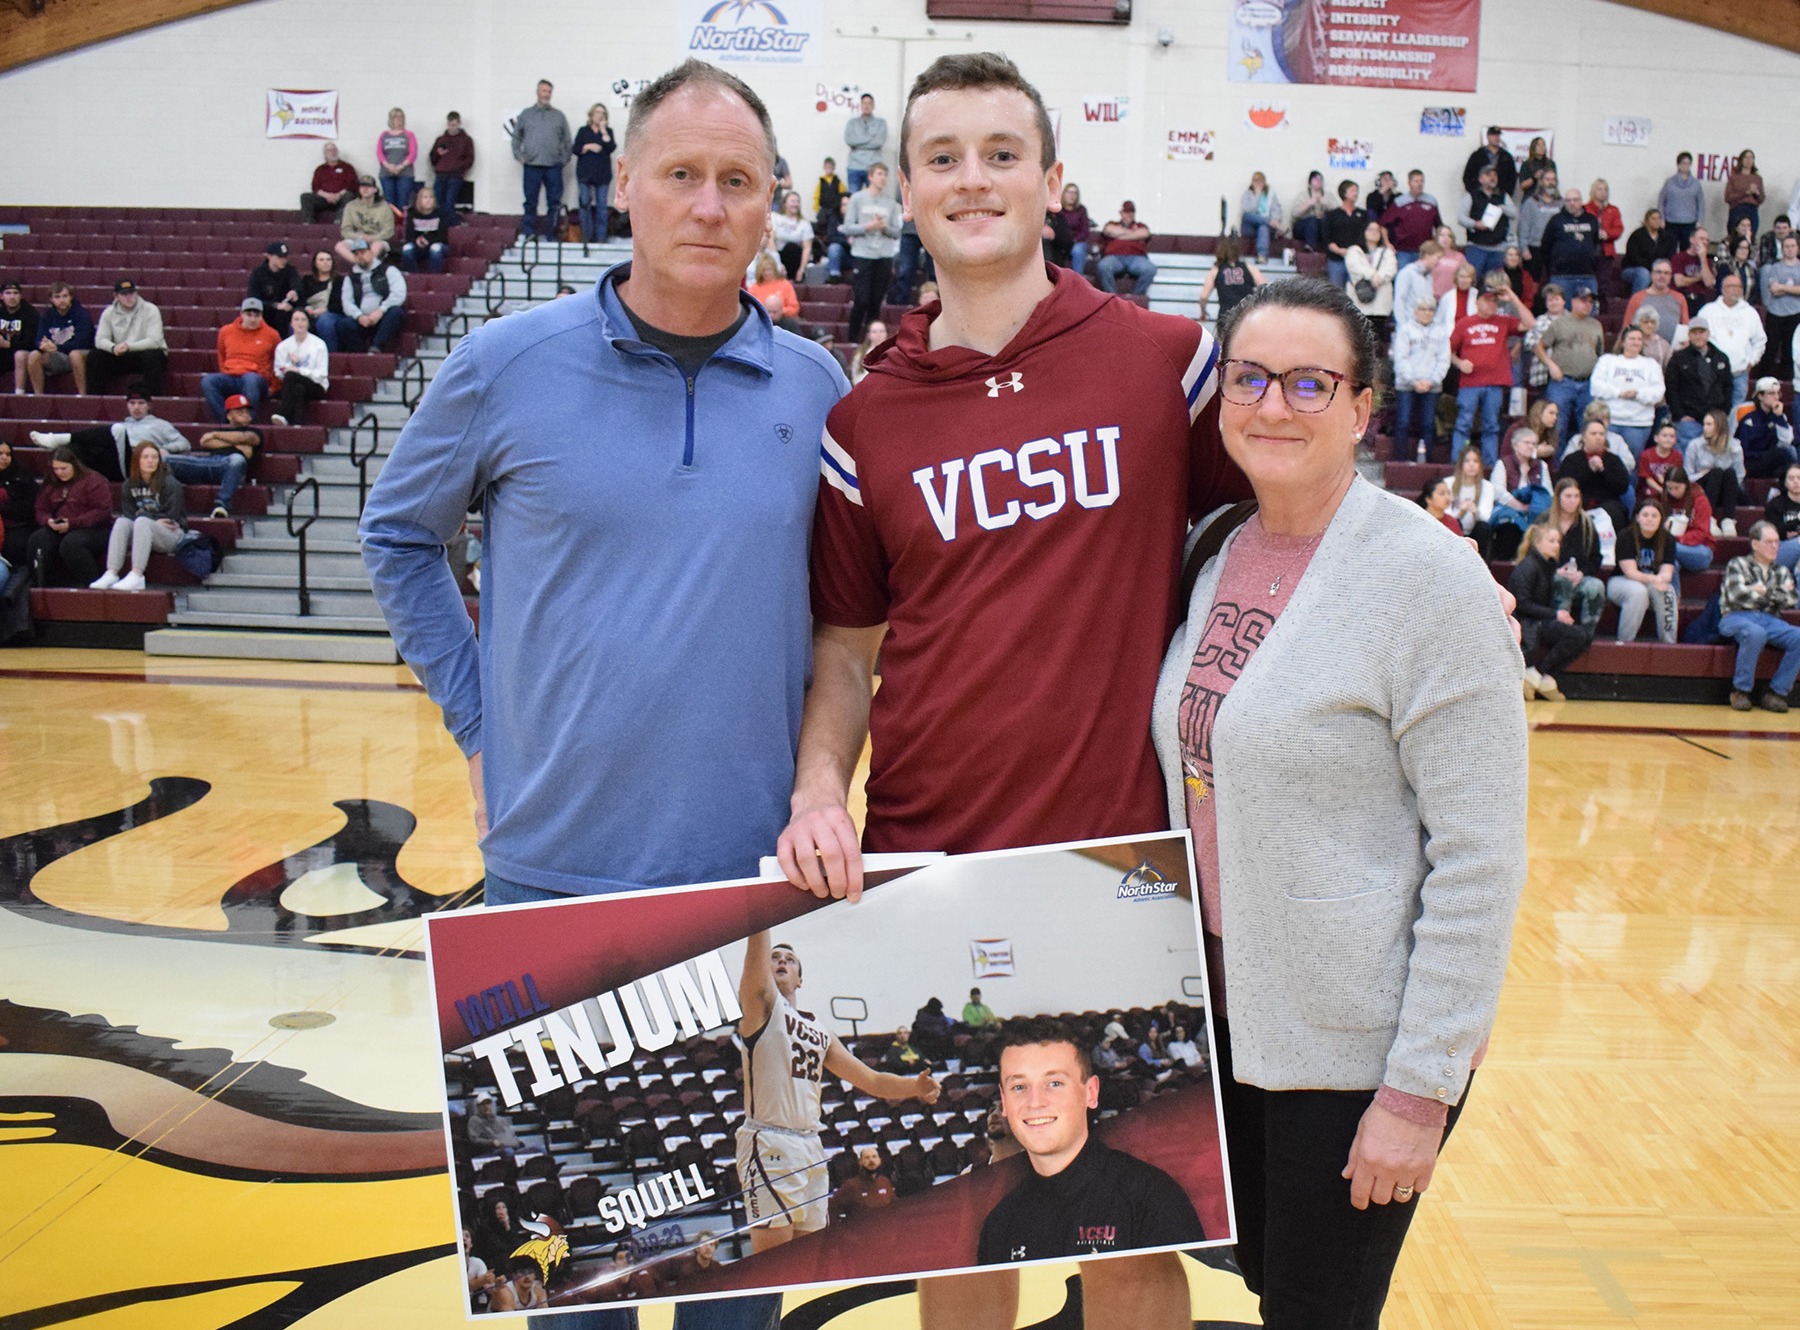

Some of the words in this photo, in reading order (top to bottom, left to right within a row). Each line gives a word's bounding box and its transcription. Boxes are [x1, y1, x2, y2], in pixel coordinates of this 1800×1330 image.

[1330, 12, 1400, 26] INTEGRITY
[690, 26, 810, 51] NorthStar
[1329, 29, 1390, 43] SERVANT
[1392, 32, 1469, 48] LEADERSHIP
[1328, 47, 1436, 63] SPORTSMANSHIP
[1328, 64, 1432, 80] RESPONSIBILITY
[295, 117, 333, 125] SECTION
[1168, 130, 1210, 144] EMMA
[911, 425, 1121, 542] VCSU
[1193, 602, 1276, 681] CS
[1117, 882, 1178, 899] NorthStar
[454, 972, 550, 1038] WILL
[471, 949, 743, 1108] TINJUM
[784, 1013, 828, 1050] VCSU
[792, 1041, 820, 1083] 22
[598, 1162, 716, 1234] SQUILL
[749, 1168, 760, 1219] VIKES
